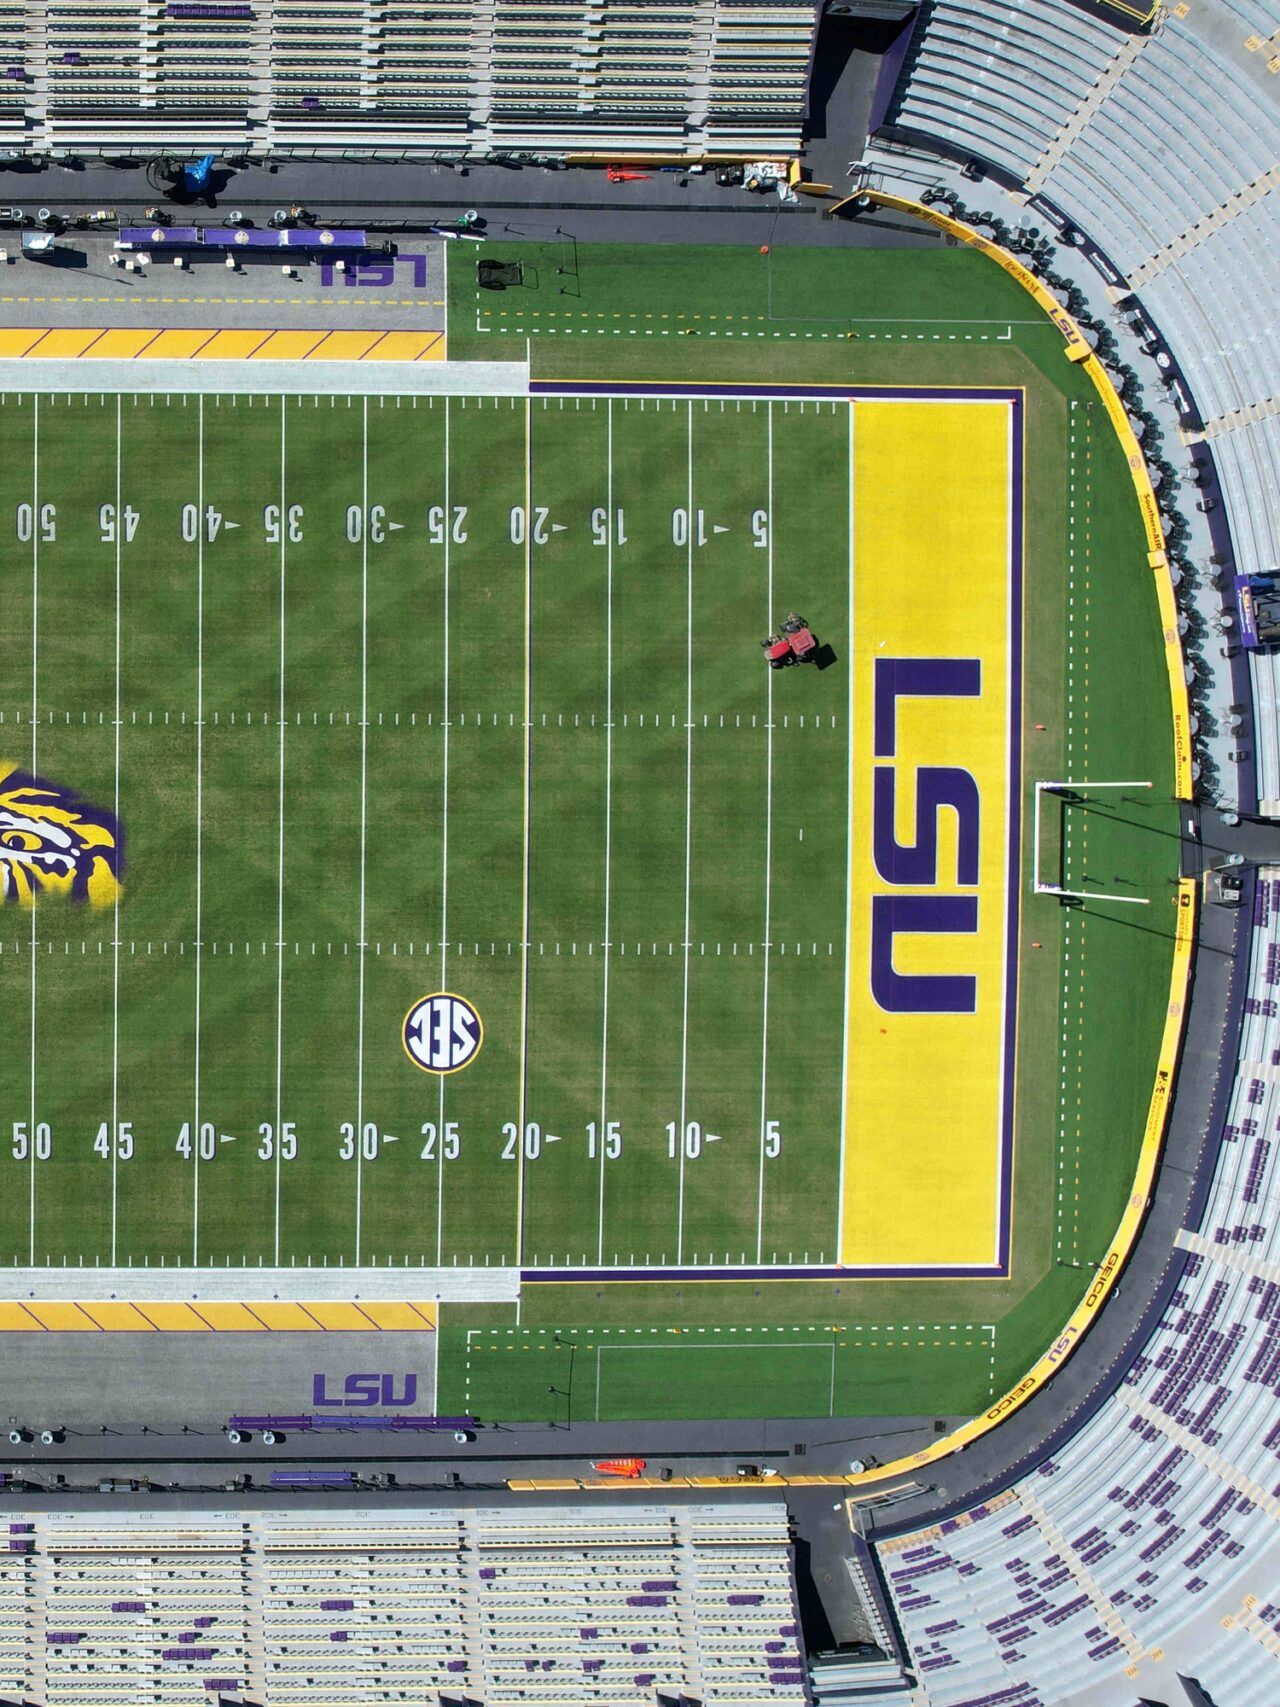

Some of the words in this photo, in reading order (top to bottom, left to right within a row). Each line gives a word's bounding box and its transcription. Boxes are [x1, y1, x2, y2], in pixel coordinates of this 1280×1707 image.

[320, 254, 427, 288] LSU
[18, 504, 55, 541] 50
[101, 504, 139, 541] 45
[183, 504, 221, 541] 40
[265, 505, 303, 542] 35
[348, 506, 385, 543] 30
[429, 507, 467, 544] 25
[511, 507, 548, 544] 20
[592, 508, 627, 545] 15
[673, 509, 707, 546] 10
[753, 510, 767, 547] 5
[1143, 493, 1162, 551] SouthernAIR
[1175, 715, 1183, 797] RoofClaim.com
[872, 658, 981, 1012] LSU
[409, 999, 475, 1068] SEC
[13, 1122, 50, 1159] 50
[94, 1122, 133, 1159] 45
[176, 1122, 214, 1159] 40
[258, 1122, 296, 1159] 35
[340, 1122, 377, 1159] 30
[421, 1122, 459, 1159] 25
[502, 1122, 540, 1159] 20
[586, 1122, 621, 1159] 15
[666, 1122, 700, 1159] 10
[766, 1122, 780, 1159] 5
[1085, 1252, 1120, 1308] GEICO
[1047, 1324, 1078, 1364] LSU
[312, 1373, 417, 1407] LSU
[986, 1376, 1037, 1421] GEICO
